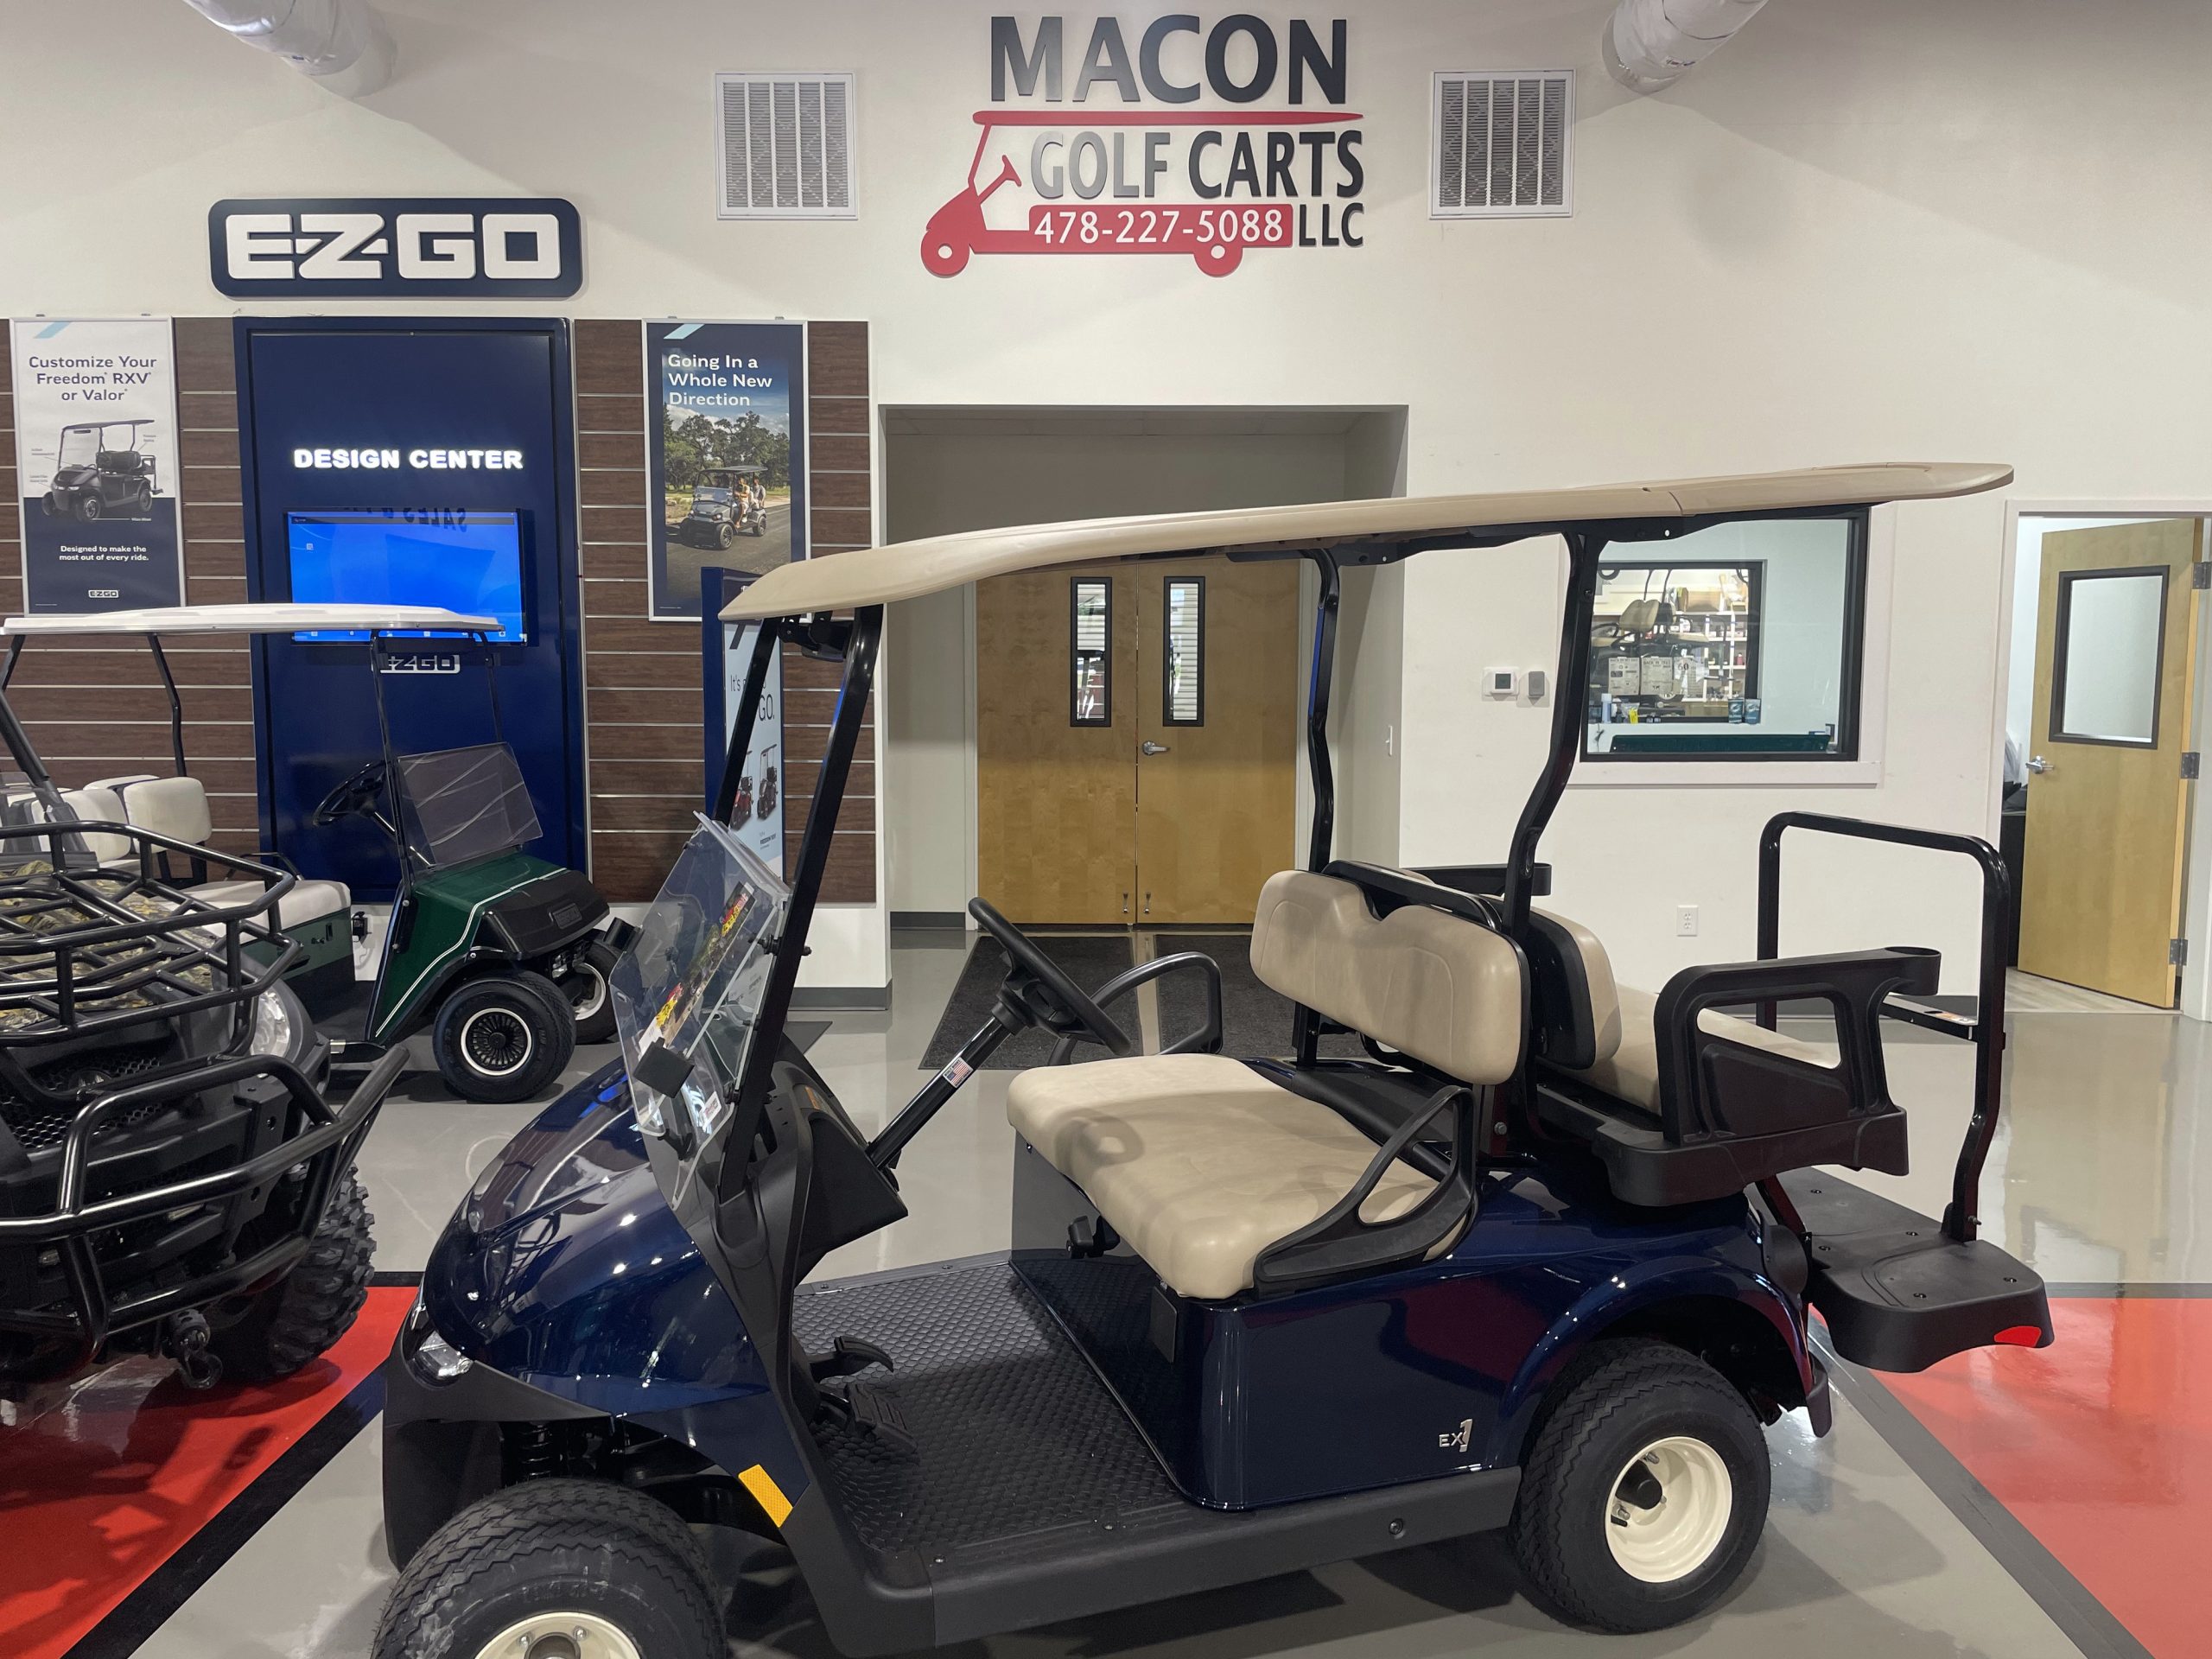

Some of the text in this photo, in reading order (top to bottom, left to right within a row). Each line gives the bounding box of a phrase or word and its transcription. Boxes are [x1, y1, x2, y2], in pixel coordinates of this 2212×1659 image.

[990, 14, 1346, 105] MACON
[1031, 130, 1364, 199] GOLF CARTS
[1033, 210, 1284, 245] 478-227-5088
[1298, 203, 1363, 247] LLC
[29, 356, 157, 367] Customize Your
[668, 354, 758, 370] Going In a
[668, 373, 772, 387] Whole New
[61, 392, 78, 401] or
[669, 392, 750, 406] Direction
[294, 448, 524, 469] DESIGN CENTER
[730, 674, 741, 692] It's
[1439, 1419, 1472, 1452] EX1
